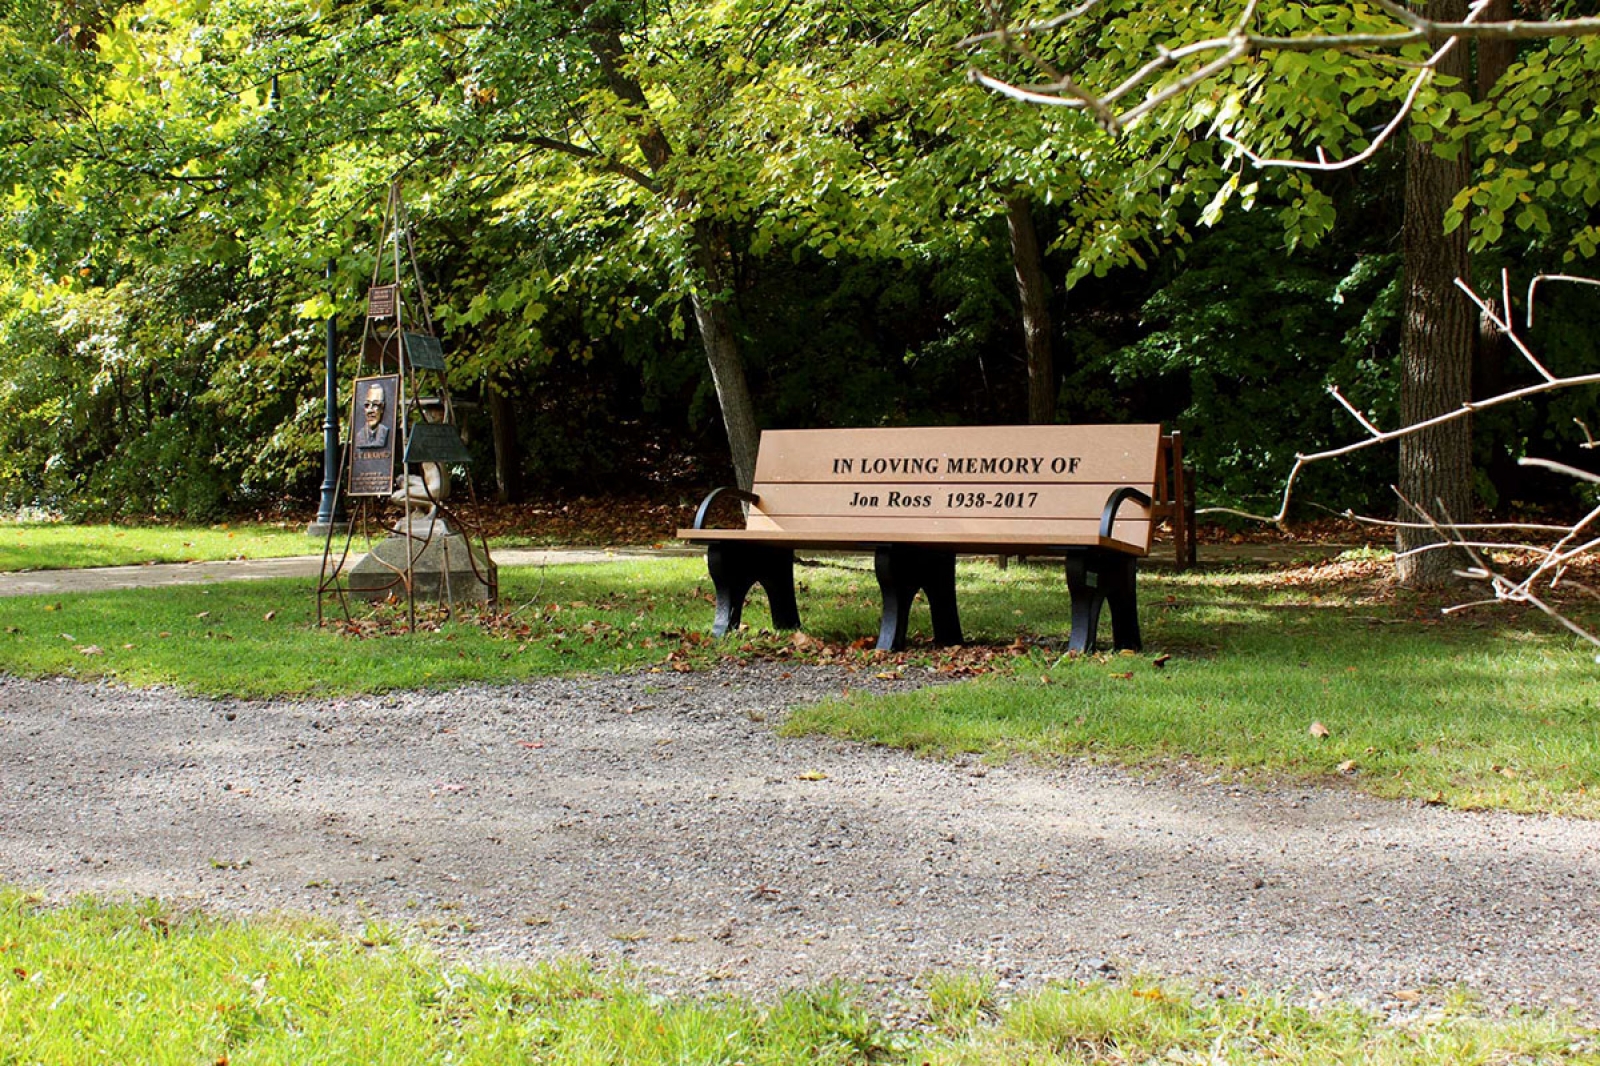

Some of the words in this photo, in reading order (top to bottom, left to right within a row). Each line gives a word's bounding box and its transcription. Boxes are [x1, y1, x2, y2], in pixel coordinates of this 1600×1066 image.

[832, 457, 854, 474] IN
[860, 457, 939, 474] LOVING
[947, 457, 1044, 474] MEMORY
[1051, 456, 1081, 474] OF
[849, 491, 880, 507] Jon
[887, 491, 932, 507] Ross
[947, 491, 1038, 508] 1938-2017
